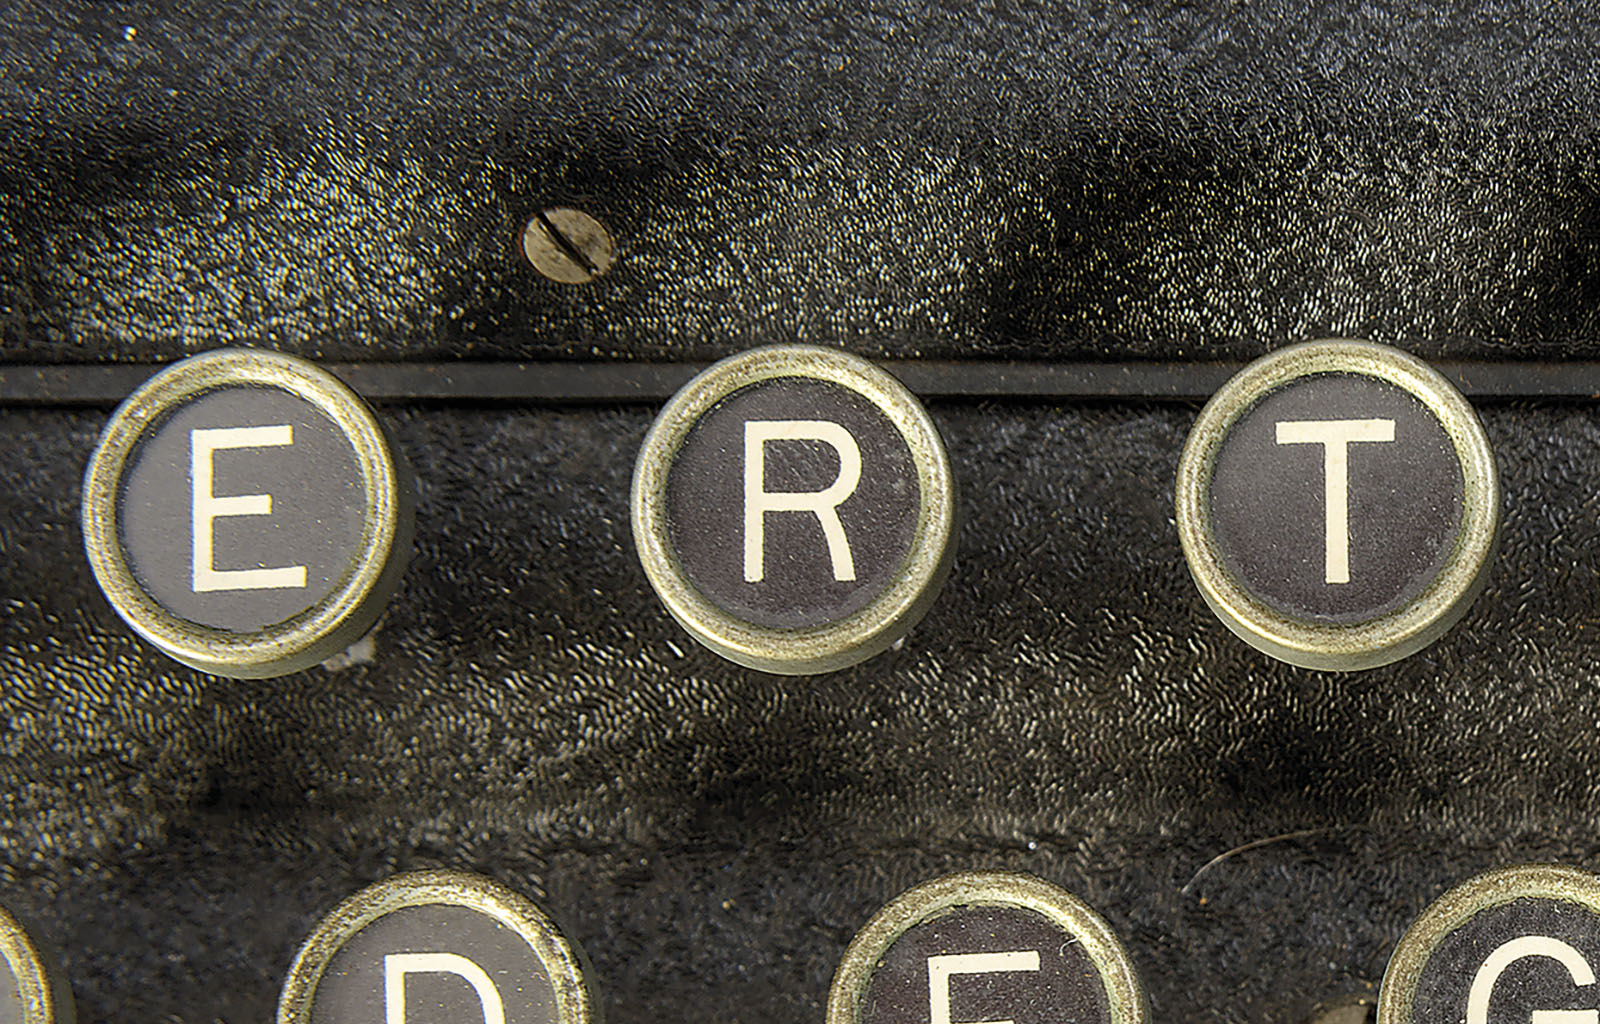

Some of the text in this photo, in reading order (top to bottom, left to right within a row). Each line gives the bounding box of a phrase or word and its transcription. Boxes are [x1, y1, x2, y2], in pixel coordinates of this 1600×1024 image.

[190, 425, 307, 592] E
[743, 420, 862, 583] R
[1275, 418, 1396, 584] T
